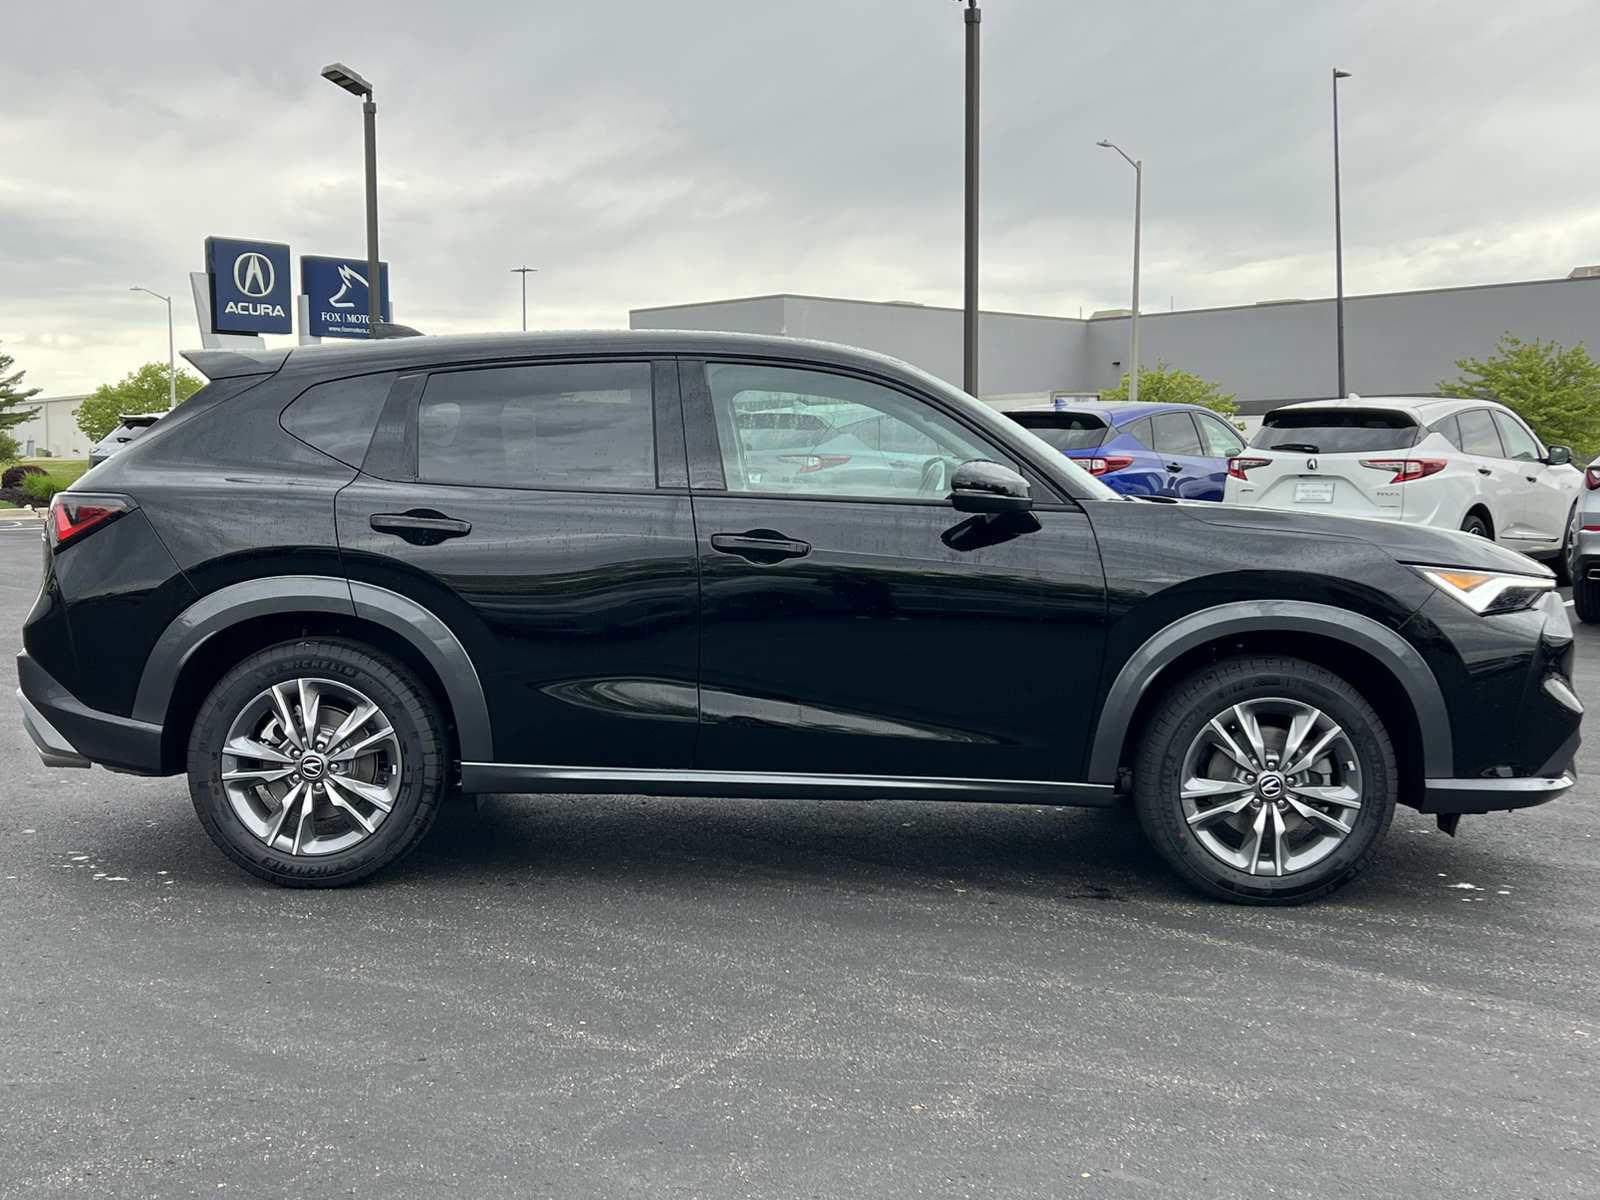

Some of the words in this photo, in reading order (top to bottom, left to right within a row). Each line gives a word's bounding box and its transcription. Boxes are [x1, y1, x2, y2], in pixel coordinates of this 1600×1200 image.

[225, 301, 285, 317] ACURA
[321, 311, 341, 323] FOX
[346, 313, 384, 324] MOTOS
[282, 660, 355, 676] MICHELIN
[265, 858, 338, 874] MICHELIN
